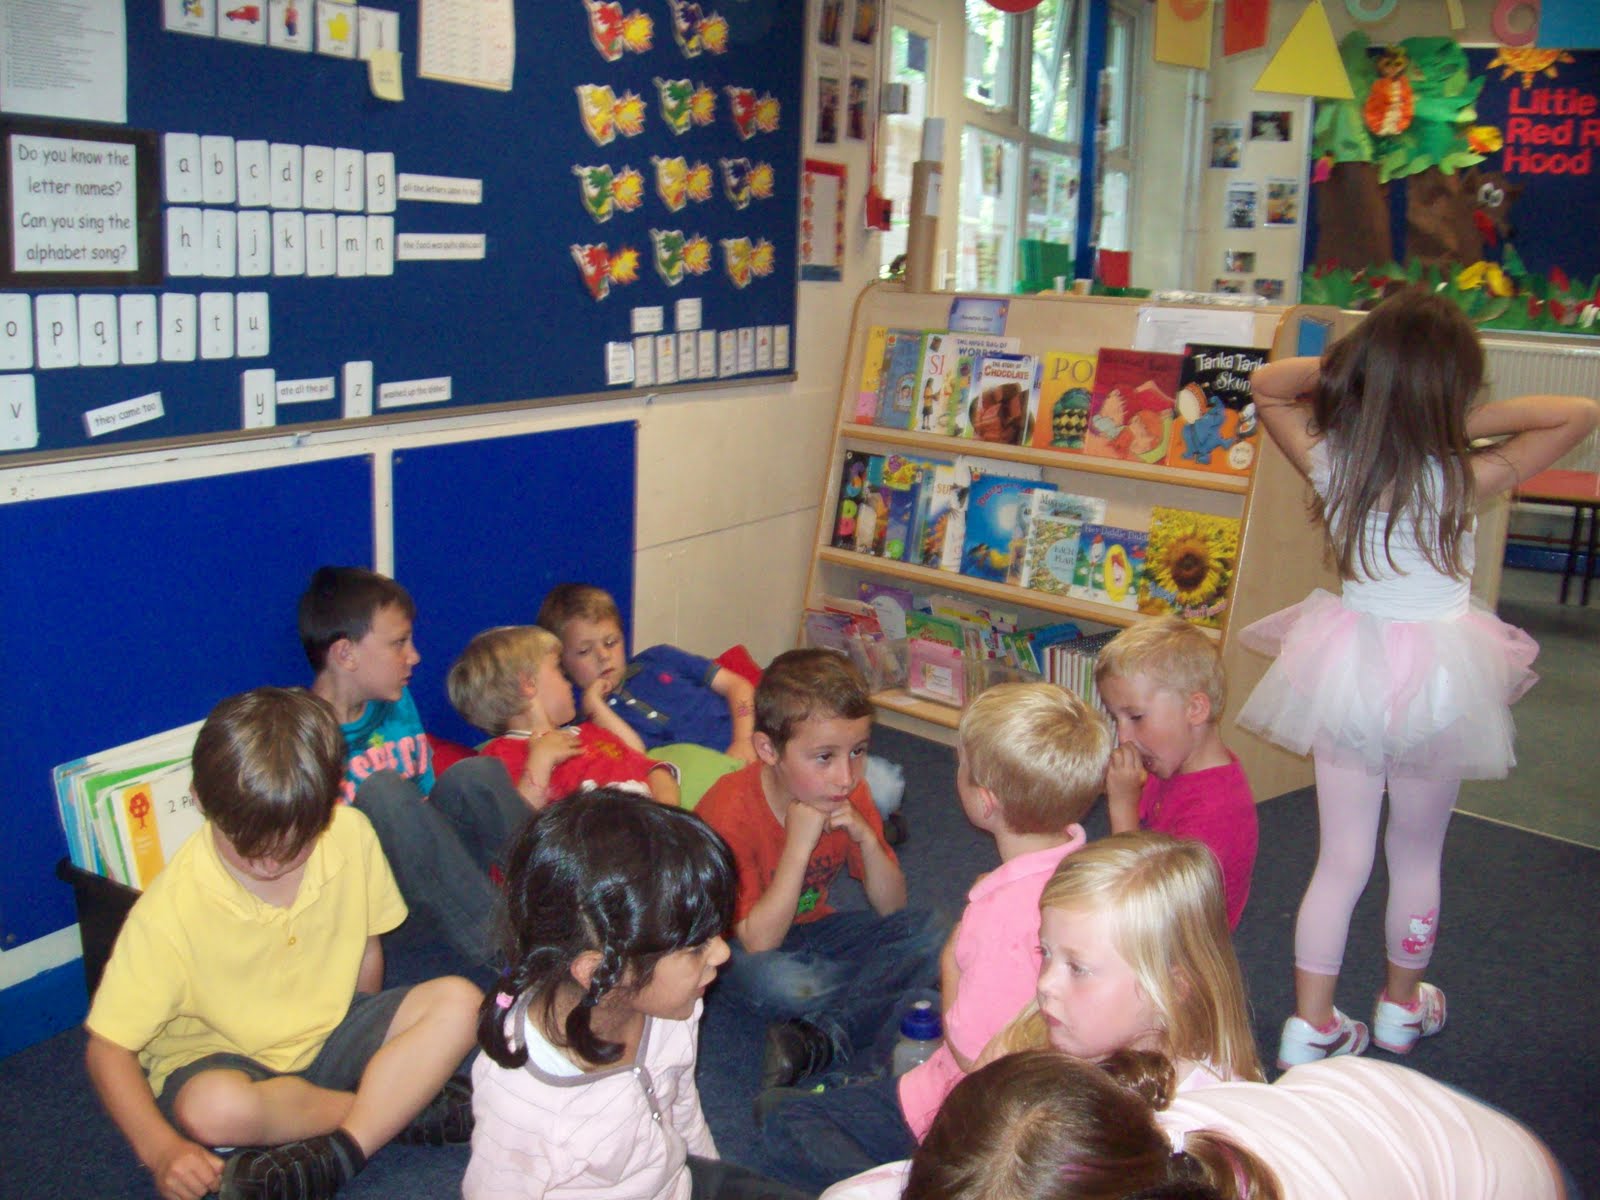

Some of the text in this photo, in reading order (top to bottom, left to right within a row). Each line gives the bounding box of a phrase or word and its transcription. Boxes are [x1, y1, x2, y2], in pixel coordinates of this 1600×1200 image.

[1509, 87, 1598, 116] Little
[1505, 117, 1575, 146] Red
[18, 143, 130, 166] Do you know the
[1501, 146, 1592, 175] Hood
[28, 175, 123, 196] letter names?
[21, 211, 131, 234] Can you sing the
[26, 241, 128, 265] alphabet song?
[984, 365, 1030, 380] CHOCOLATE
[1194, 352, 1235, 371] Tanka
[1235, 354, 1270, 371] Tank
[1215, 371, 1251, 391] Skun
[94, 413, 117, 427] they
